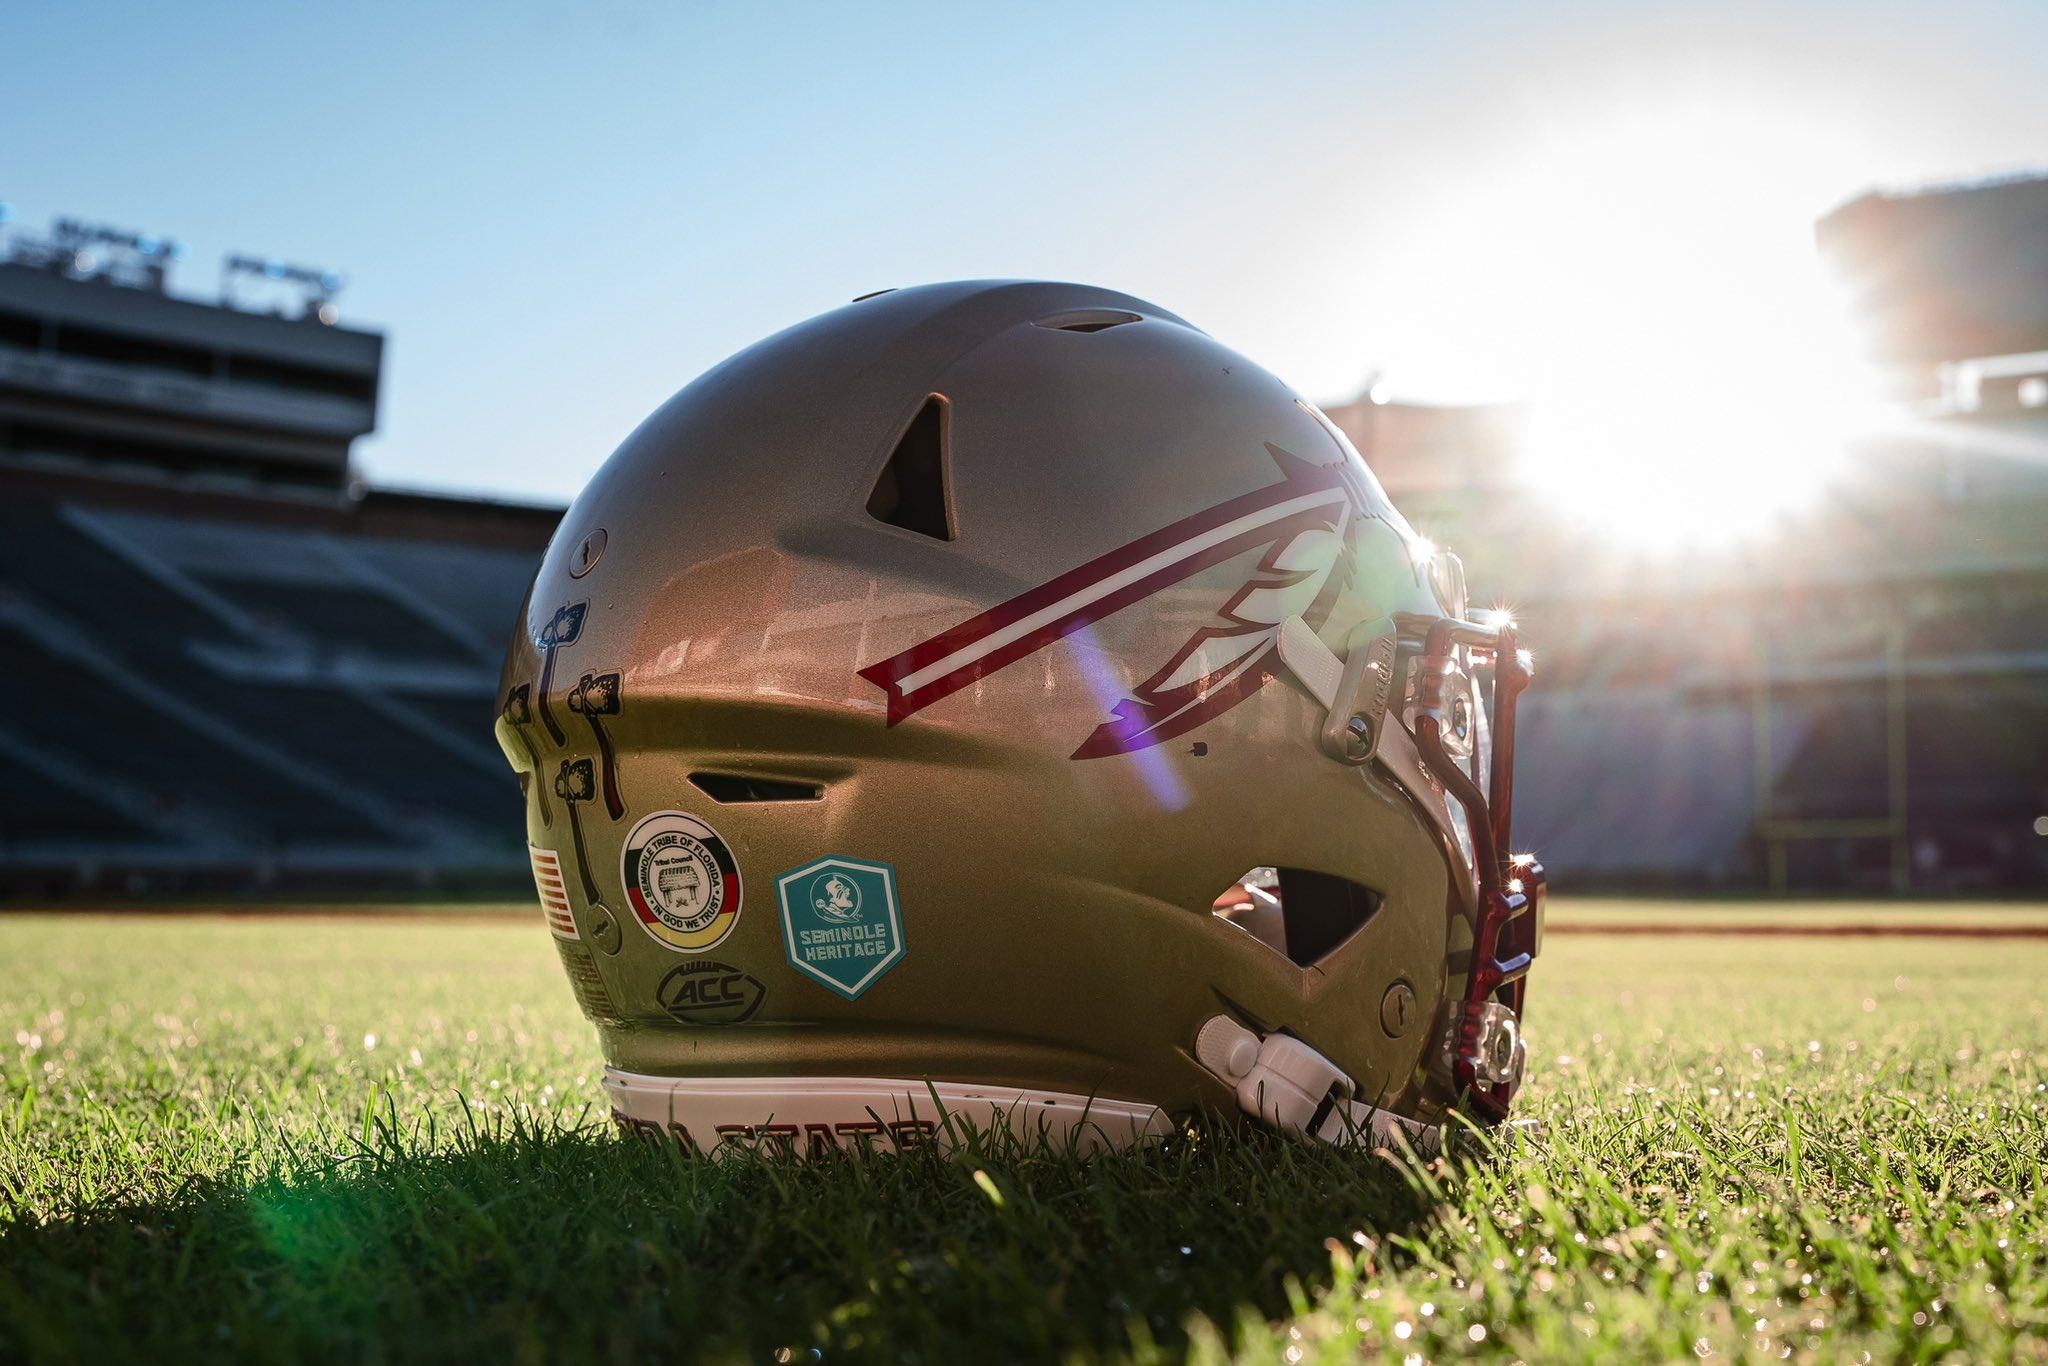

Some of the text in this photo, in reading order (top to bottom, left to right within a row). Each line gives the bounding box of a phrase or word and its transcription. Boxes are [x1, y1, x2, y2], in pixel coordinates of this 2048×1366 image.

[640, 835, 721, 899] SEMINOLE TRIBE OF FLORIDA
[654, 854, 693, 867] Tribal Council
[653, 894, 721, 929] IN GOD WE TRUST
[800, 923, 886, 945] SEMINOLE
[805, 940, 887, 961] HERITAGE
[671, 974, 745, 1004] ACC
